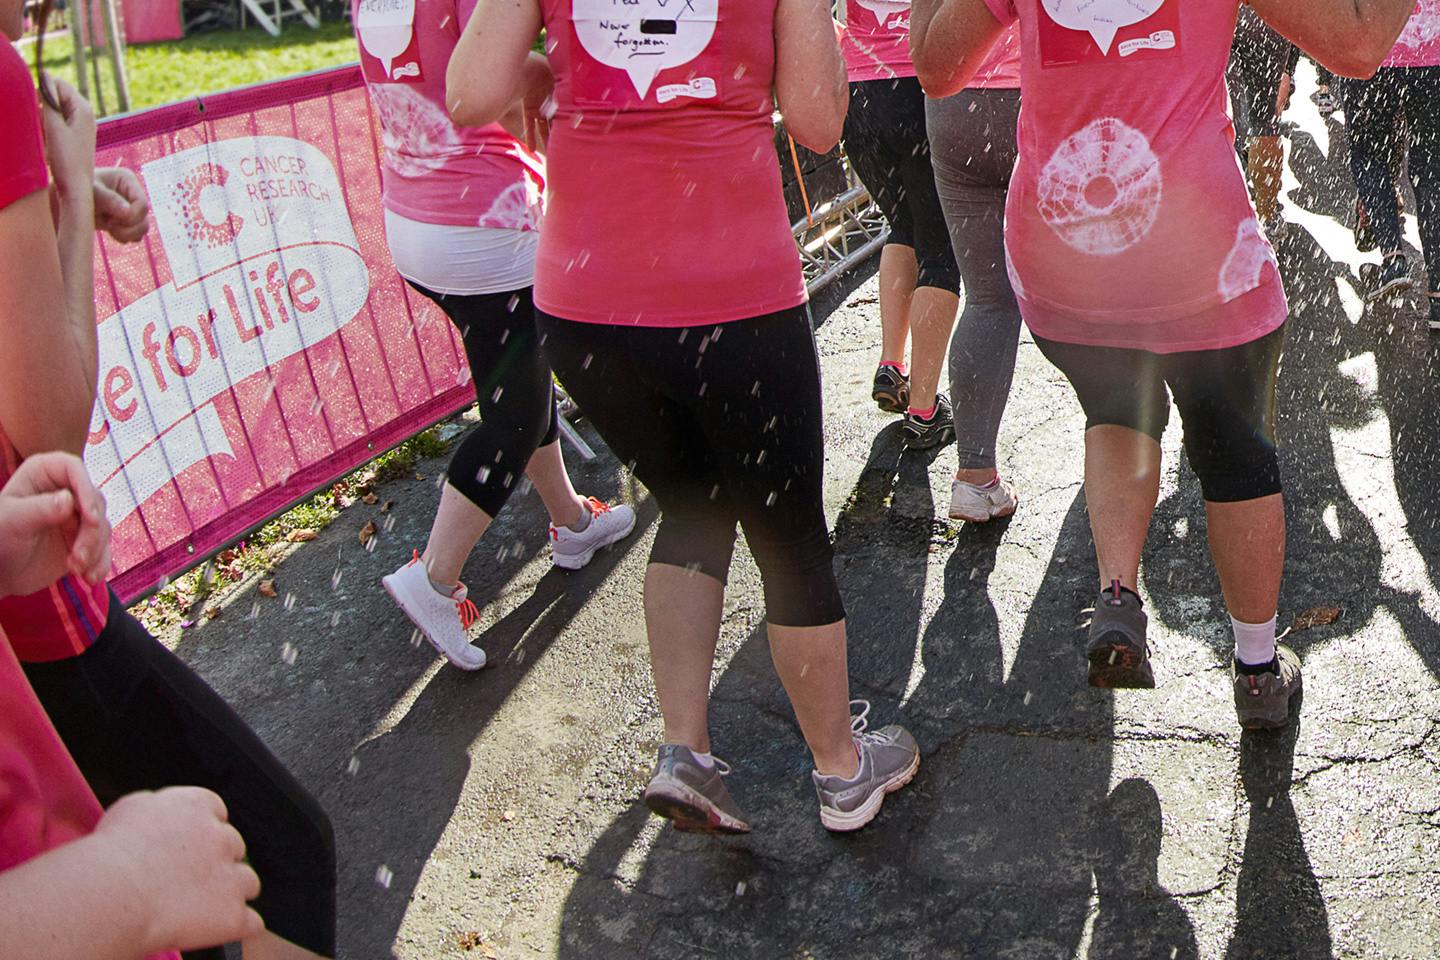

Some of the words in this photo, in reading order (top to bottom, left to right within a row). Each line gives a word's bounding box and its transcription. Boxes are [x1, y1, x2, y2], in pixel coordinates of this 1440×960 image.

[240, 155, 309, 177] CANCER
[246, 180, 331, 204] RESEARCH
[253, 206, 281, 227] UK
[142, 308, 218, 392] for
[223, 261, 321, 343] Life
